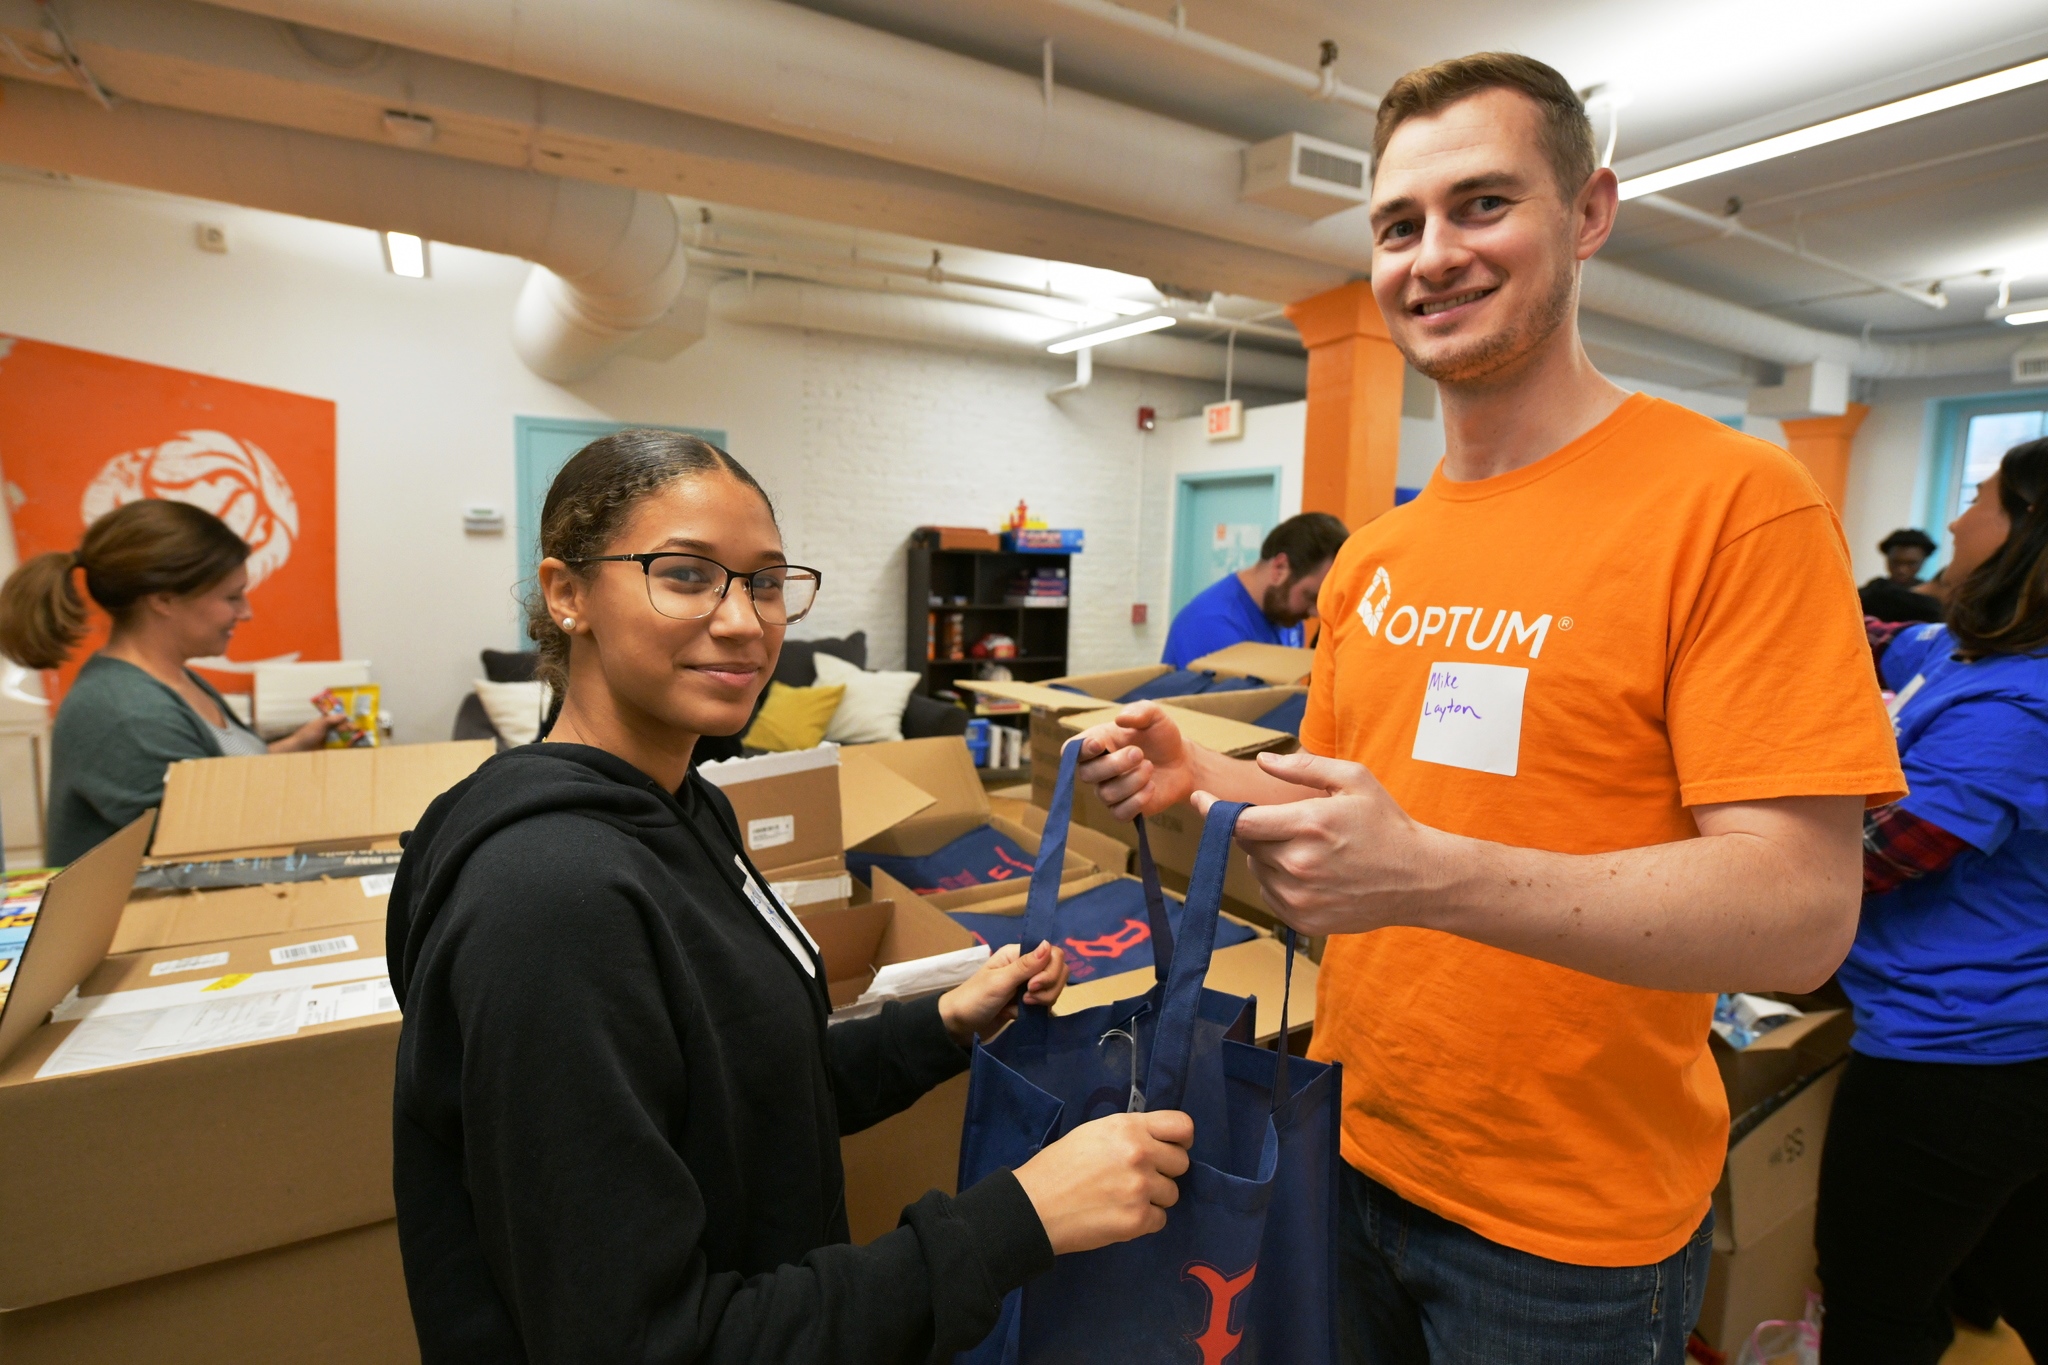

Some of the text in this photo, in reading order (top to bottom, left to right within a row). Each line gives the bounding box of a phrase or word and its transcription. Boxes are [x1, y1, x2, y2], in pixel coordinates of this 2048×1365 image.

[1385, 605, 1553, 659] OPTUM
[1428, 671, 1459, 691] Mike
[1424, 698, 1483, 723] Layton
